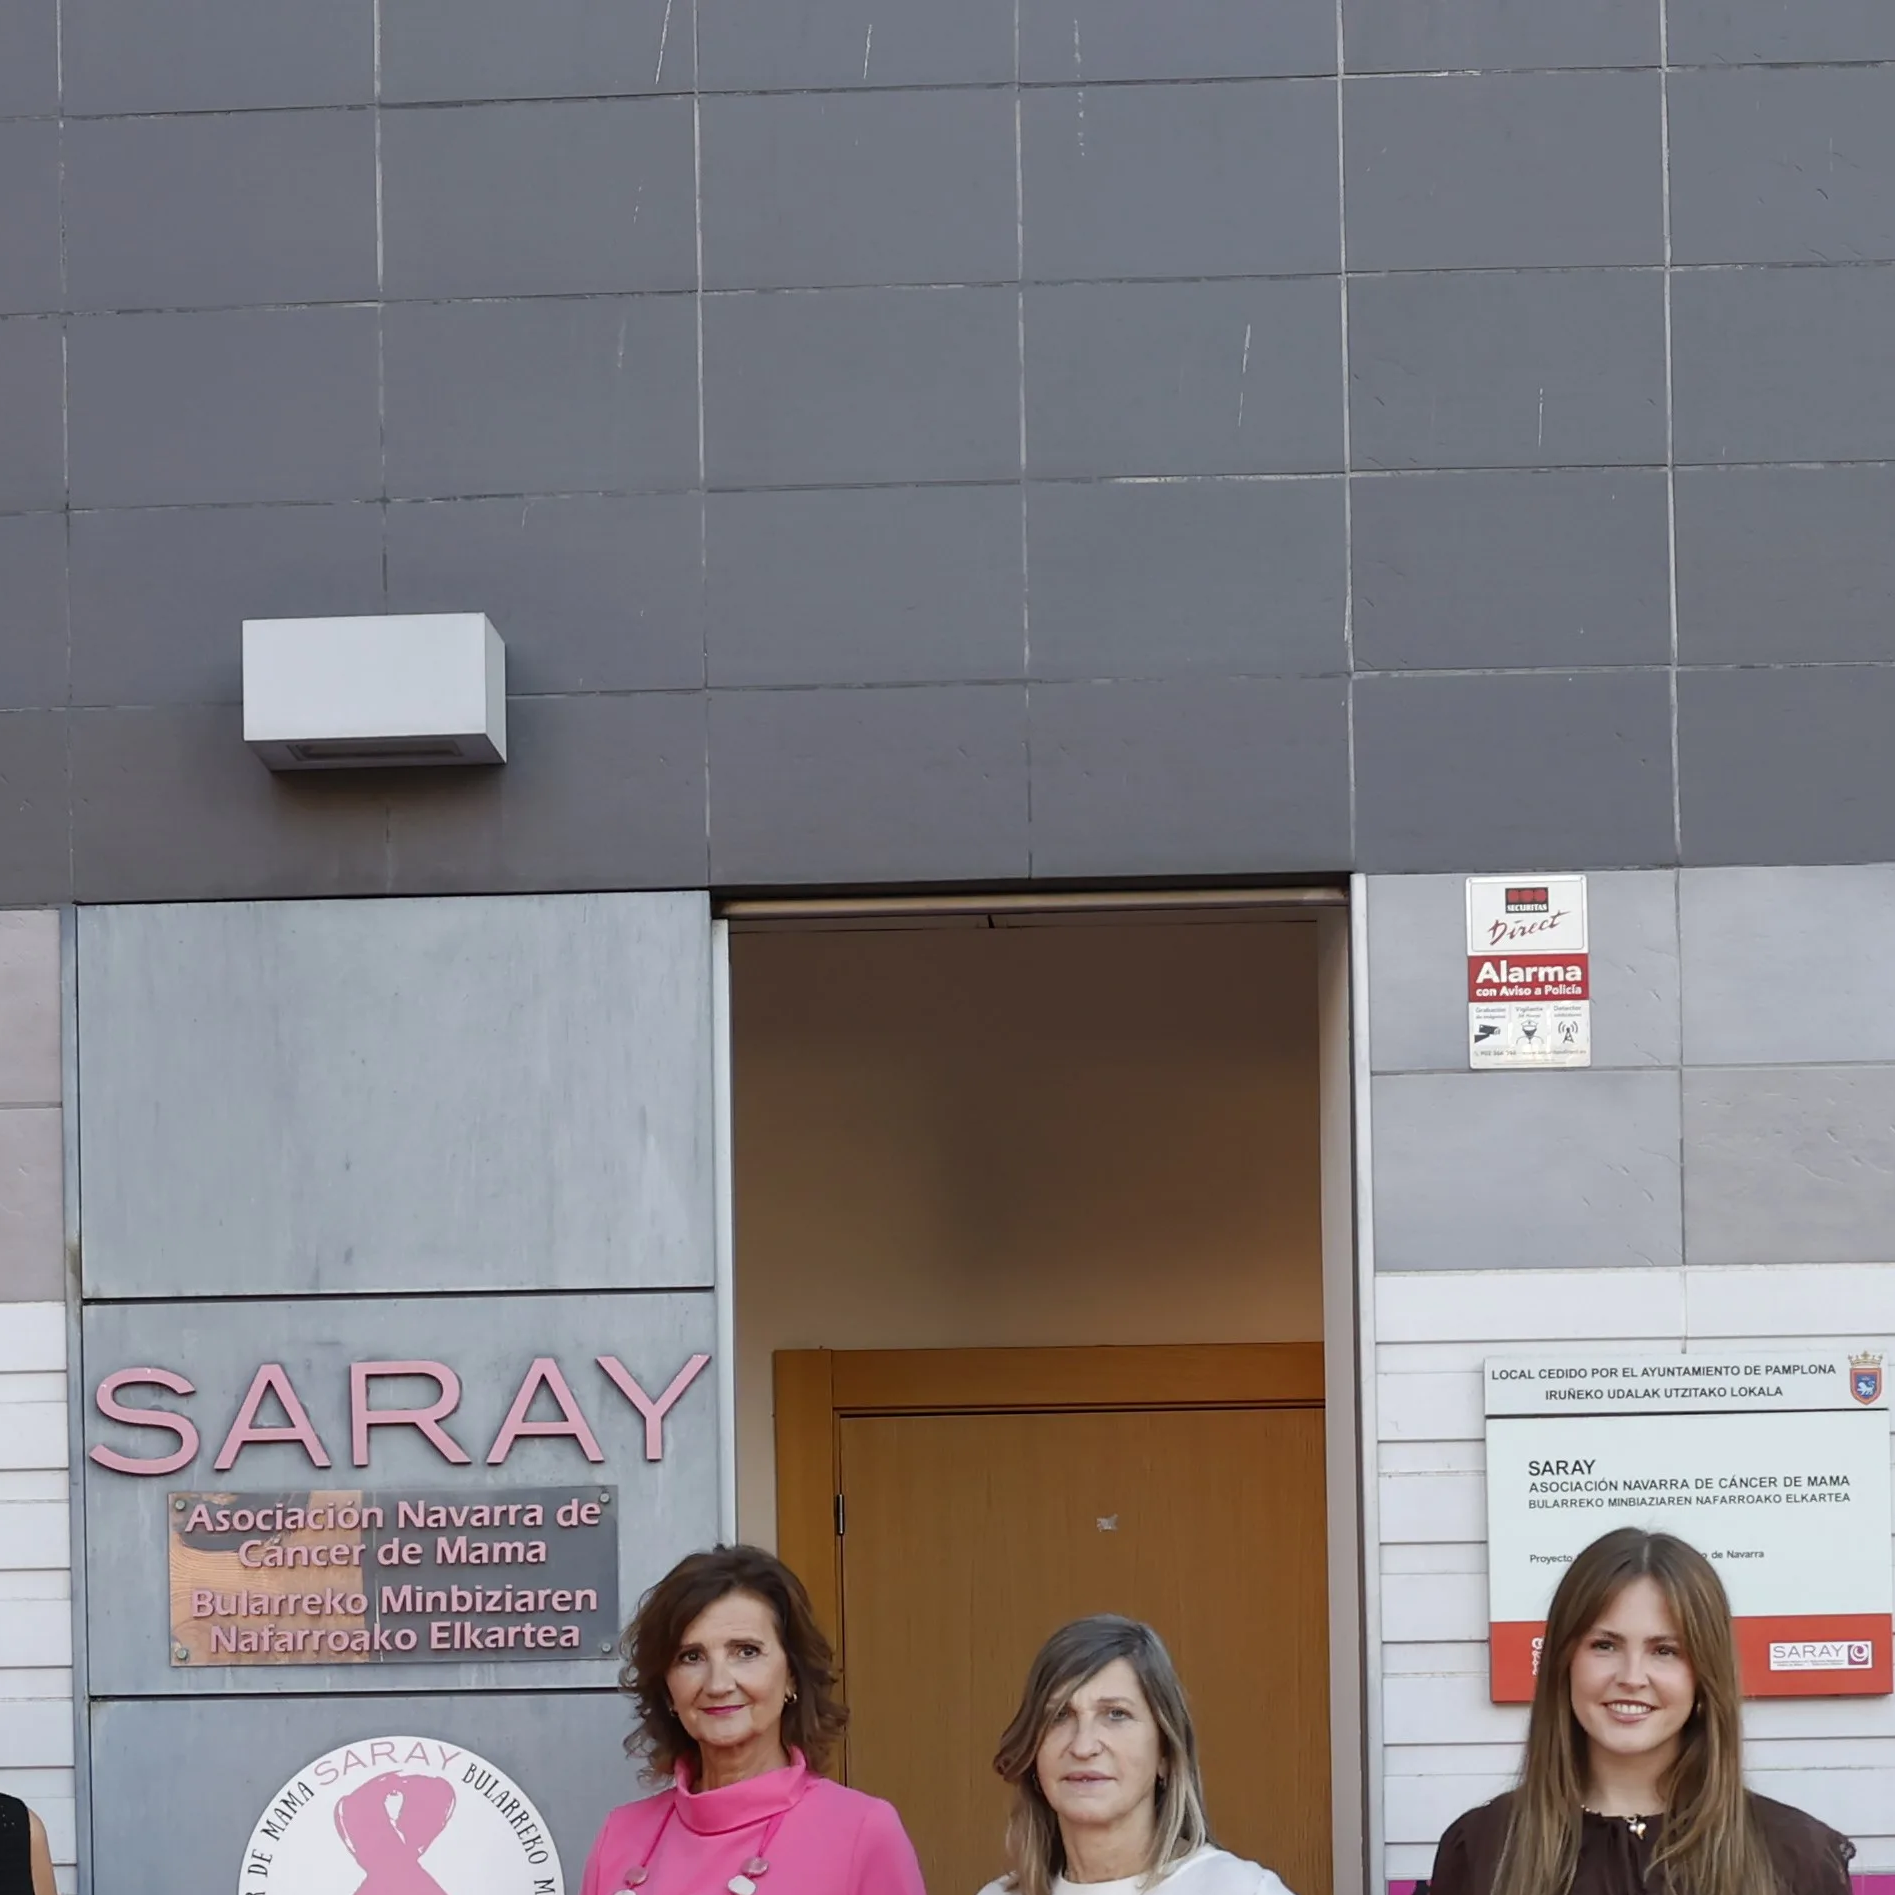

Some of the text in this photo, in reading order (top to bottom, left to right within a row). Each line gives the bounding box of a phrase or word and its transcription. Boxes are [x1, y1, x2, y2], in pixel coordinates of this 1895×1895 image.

[1506, 903, 1548, 912] SECURITAS
[1487, 909, 1572, 946] Direct
[1475, 960, 1582, 984] Alarma
[1475, 984, 1582, 997] con Aviso a Policía
[1492, 1364, 1836, 1380] LOCAL CEDIDO POR EL AYUNTAMIENTO DE PAMPLONA
[1546, 1386, 1783, 1400] IRUÑEKO UDALAK UTZITAKO LOKALA
[88, 1353, 711, 1476] SARAY
[1529, 1460, 1595, 1476] SARAY
[1529, 1475, 1850, 1493] ASOCIACIÓN NAVARRA DE CÁNCER DE MAMA
[1529, 1493, 1850, 1509] BULARREKO MINBIAZIAREN NAFARROAKO ELKARTEA
[185, 1498, 601, 1533] Asociación Navarra de
[238, 1535, 547, 1569] Cáncer de Mama
[1529, 1554, 1573, 1564] Proyecto
[1711, 1550, 1764, 1559] de Navarra
[190, 1583, 598, 1618] Bularreko Minbiziaren
[210, 1620, 581, 1654] Nafarroako Elkartea
[1773, 1644, 1844, 1659] SARAY
[314, 1741, 462, 1786] SARAY
[461, 1762, 549, 1866] BULARREKO
[247, 1849, 273, 1878] DE
[260, 1780, 315, 1841] MAMA
